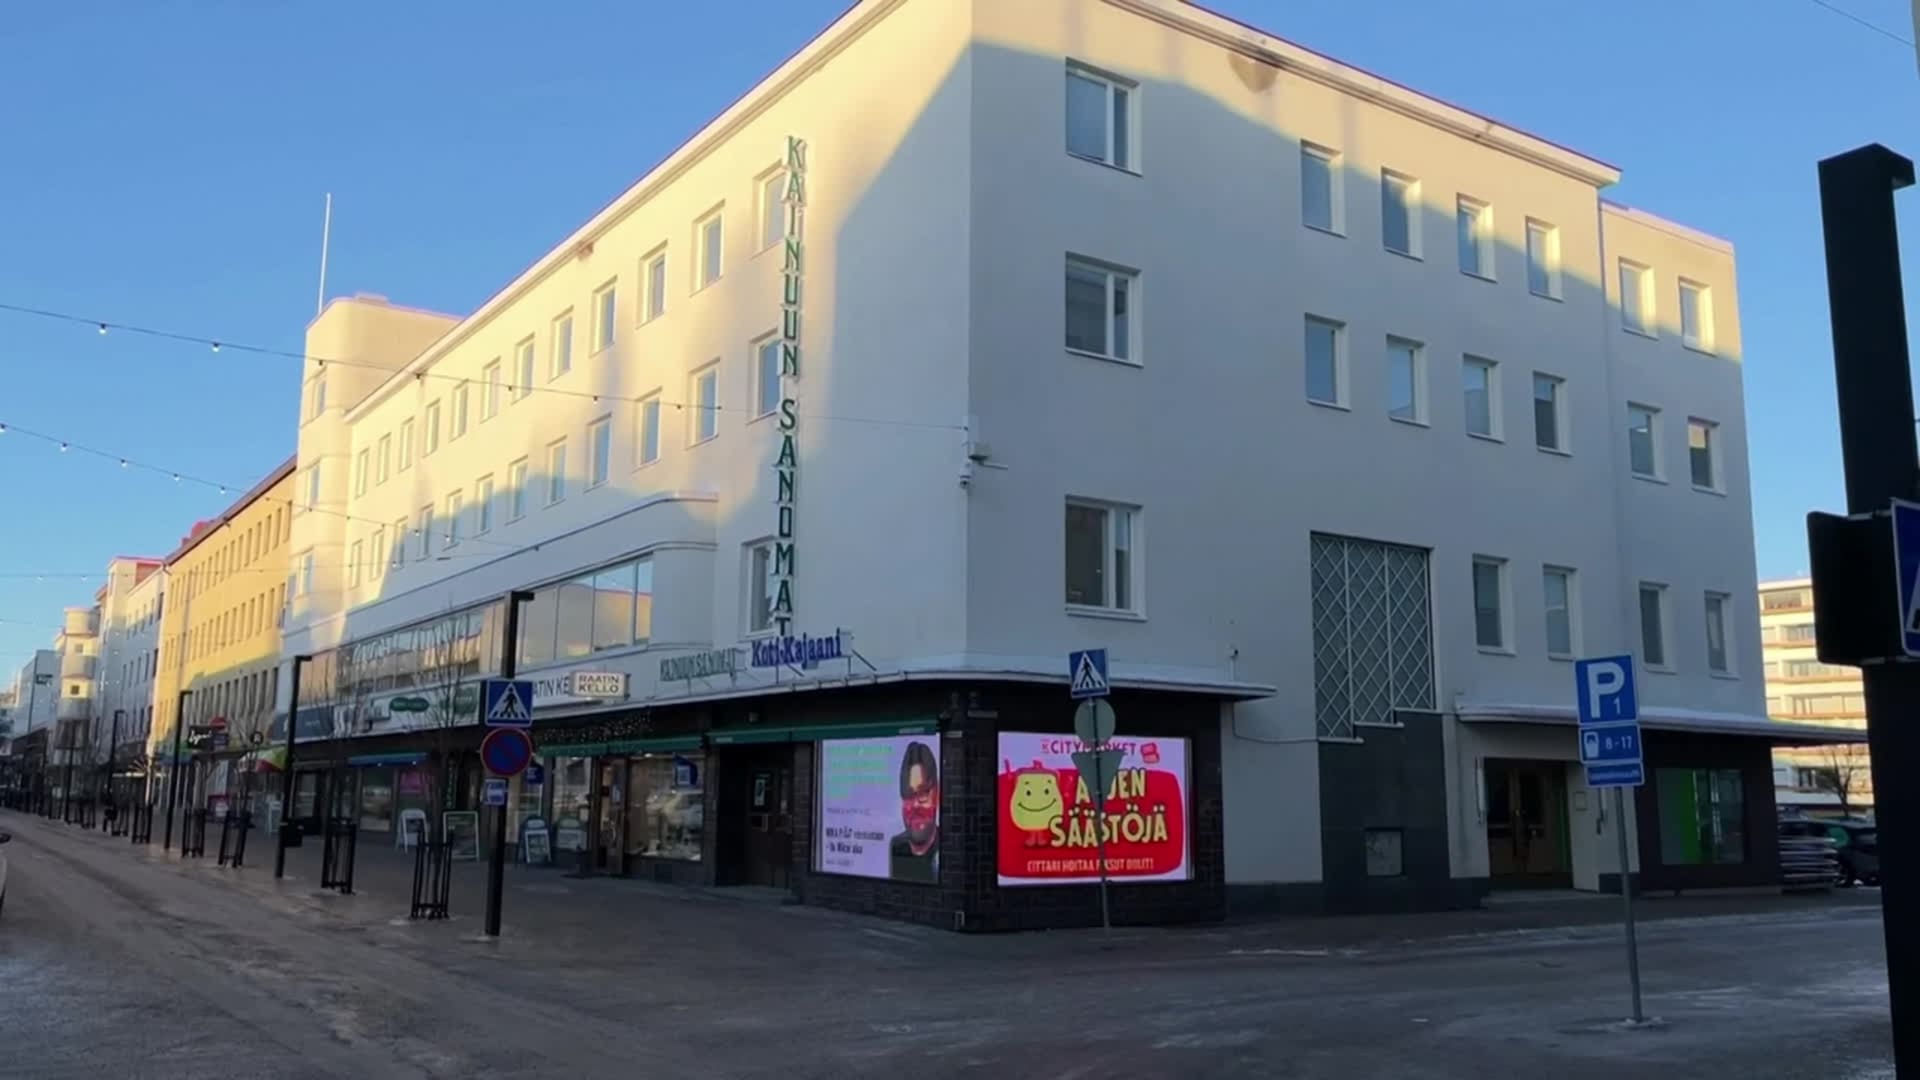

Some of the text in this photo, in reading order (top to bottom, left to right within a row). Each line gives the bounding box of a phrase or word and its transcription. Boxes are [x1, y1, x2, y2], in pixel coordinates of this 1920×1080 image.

[774, 135, 806, 636] KAINUUN SANOMAT
[578, 674, 620, 683] RAATIN
[578, 683, 620, 694] KELLO
[1587, 661, 1625, 719] P
[1613, 696, 1621, 715] 1
[1050, 740, 1137, 755] CITYKET
[1075, 768, 1146, 804] AJEN
